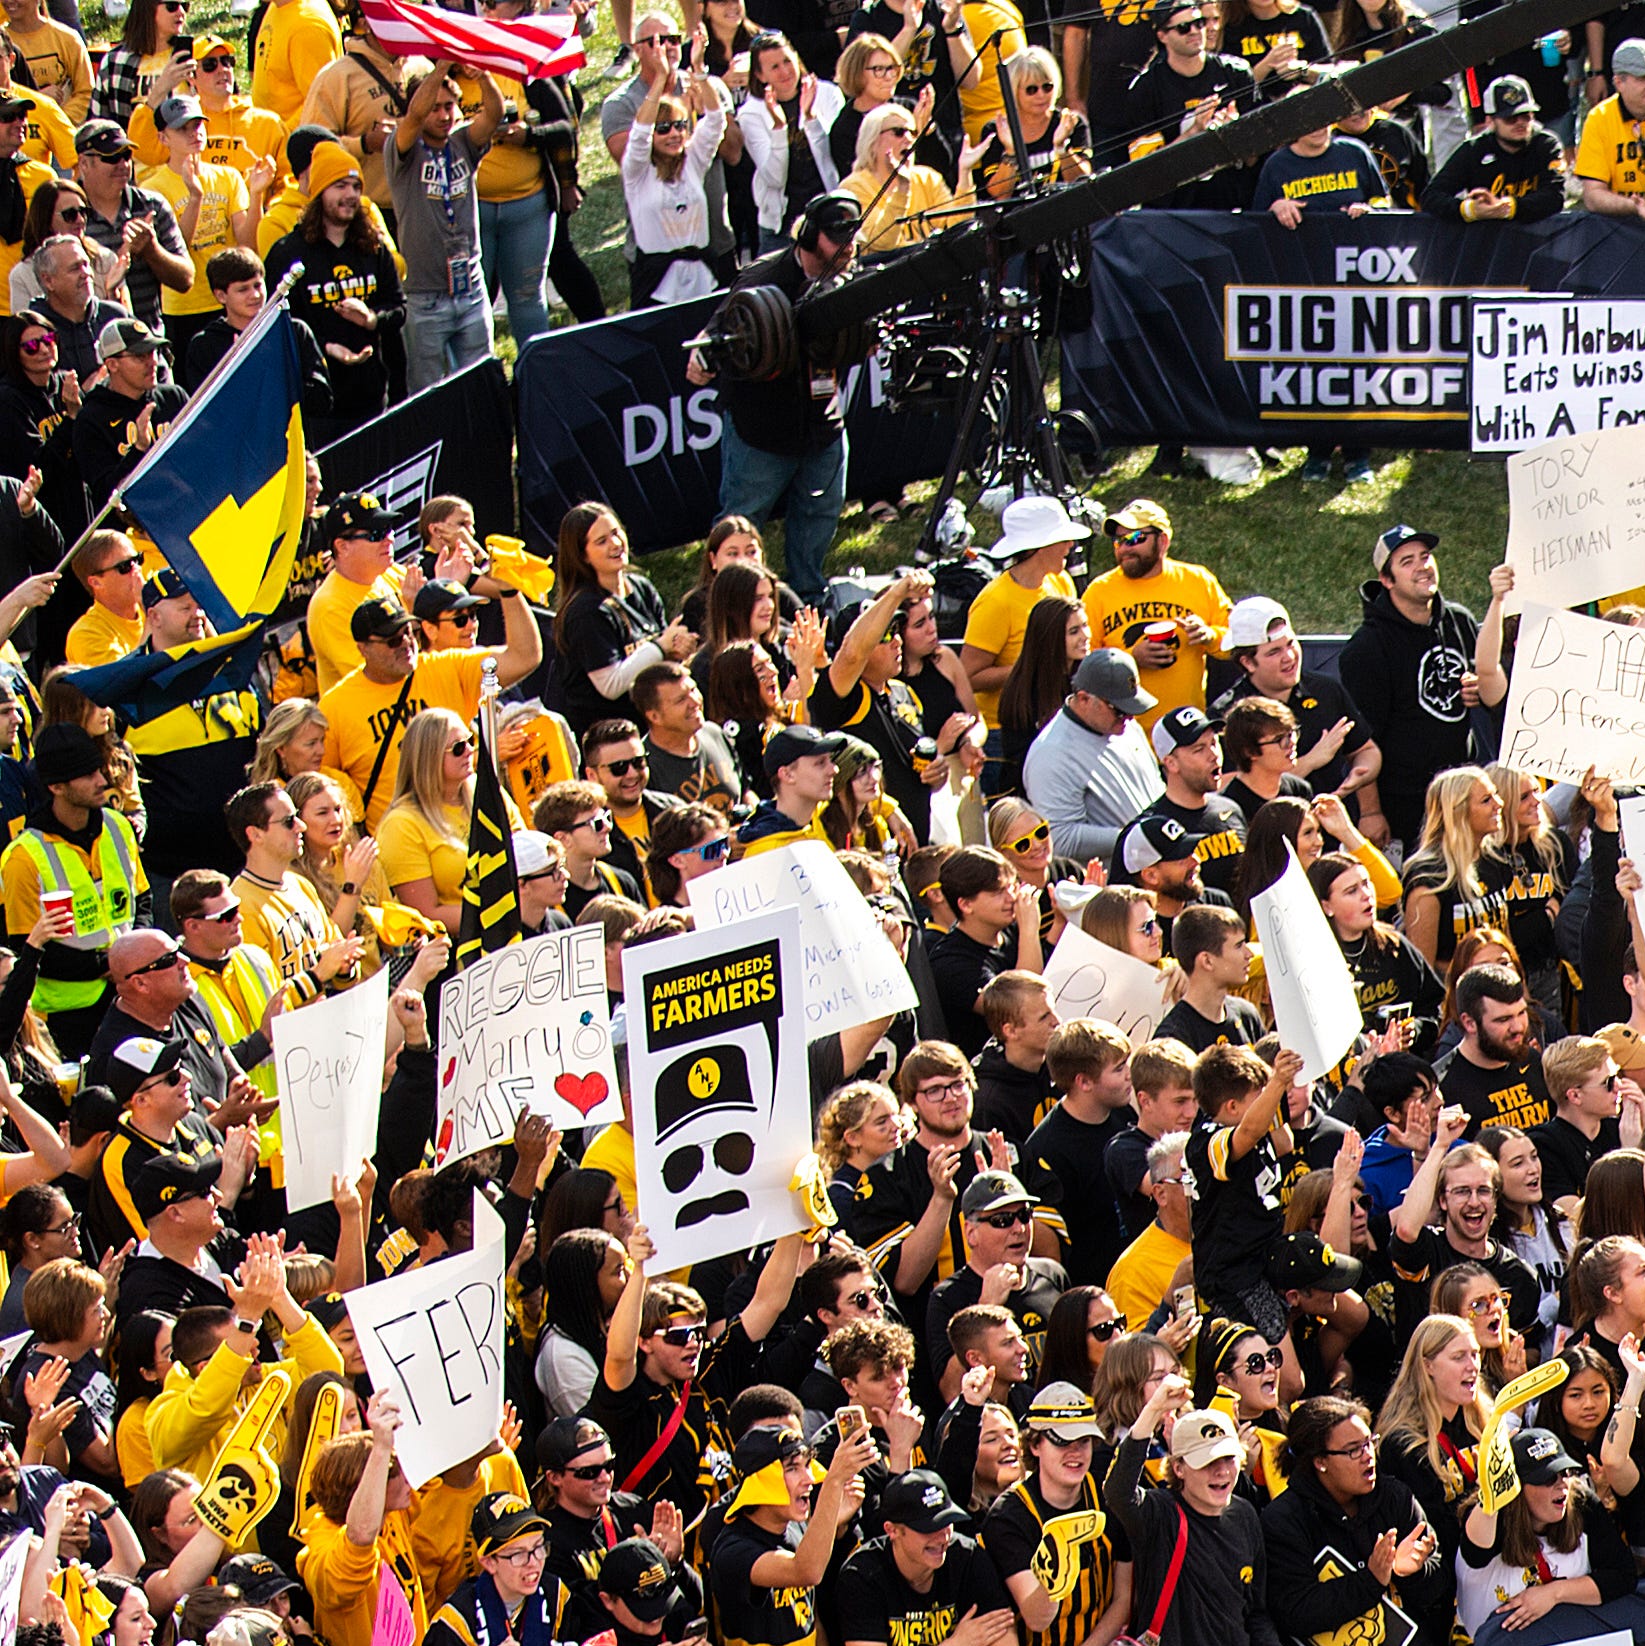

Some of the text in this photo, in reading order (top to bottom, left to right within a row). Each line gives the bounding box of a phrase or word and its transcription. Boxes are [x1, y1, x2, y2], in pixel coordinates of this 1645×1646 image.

[1282, 170, 1358, 201] MICHIGAN
[1335, 246, 1418, 283] FOX
[307, 274, 378, 304] IOWA
[1237, 295, 1468, 353] BIG NOO
[1477, 307, 1548, 358] Jim
[1258, 366, 1464, 406] KICKOF
[1504, 359, 1644, 394] Eats Wings
[1475, 404, 1535, 442] With
[1550, 402, 1577, 437] A
[1522, 437, 1600, 494] TORY
[1531, 485, 1604, 521] TAYLOR
[1531, 525, 1612, 577] HEISMAN
[1504, 728, 1596, 780] Puntin
[1192, 831, 1245, 862] OWA
[439, 928, 606, 1043] REGGIE
[651, 969, 723, 1002] AMERICA
[725, 954, 773, 986] NEEDS
[650, 972, 777, 1033] FARMERS
[458, 1023, 566, 1078] Marry
[1488, 1083, 1533, 1112] THE
